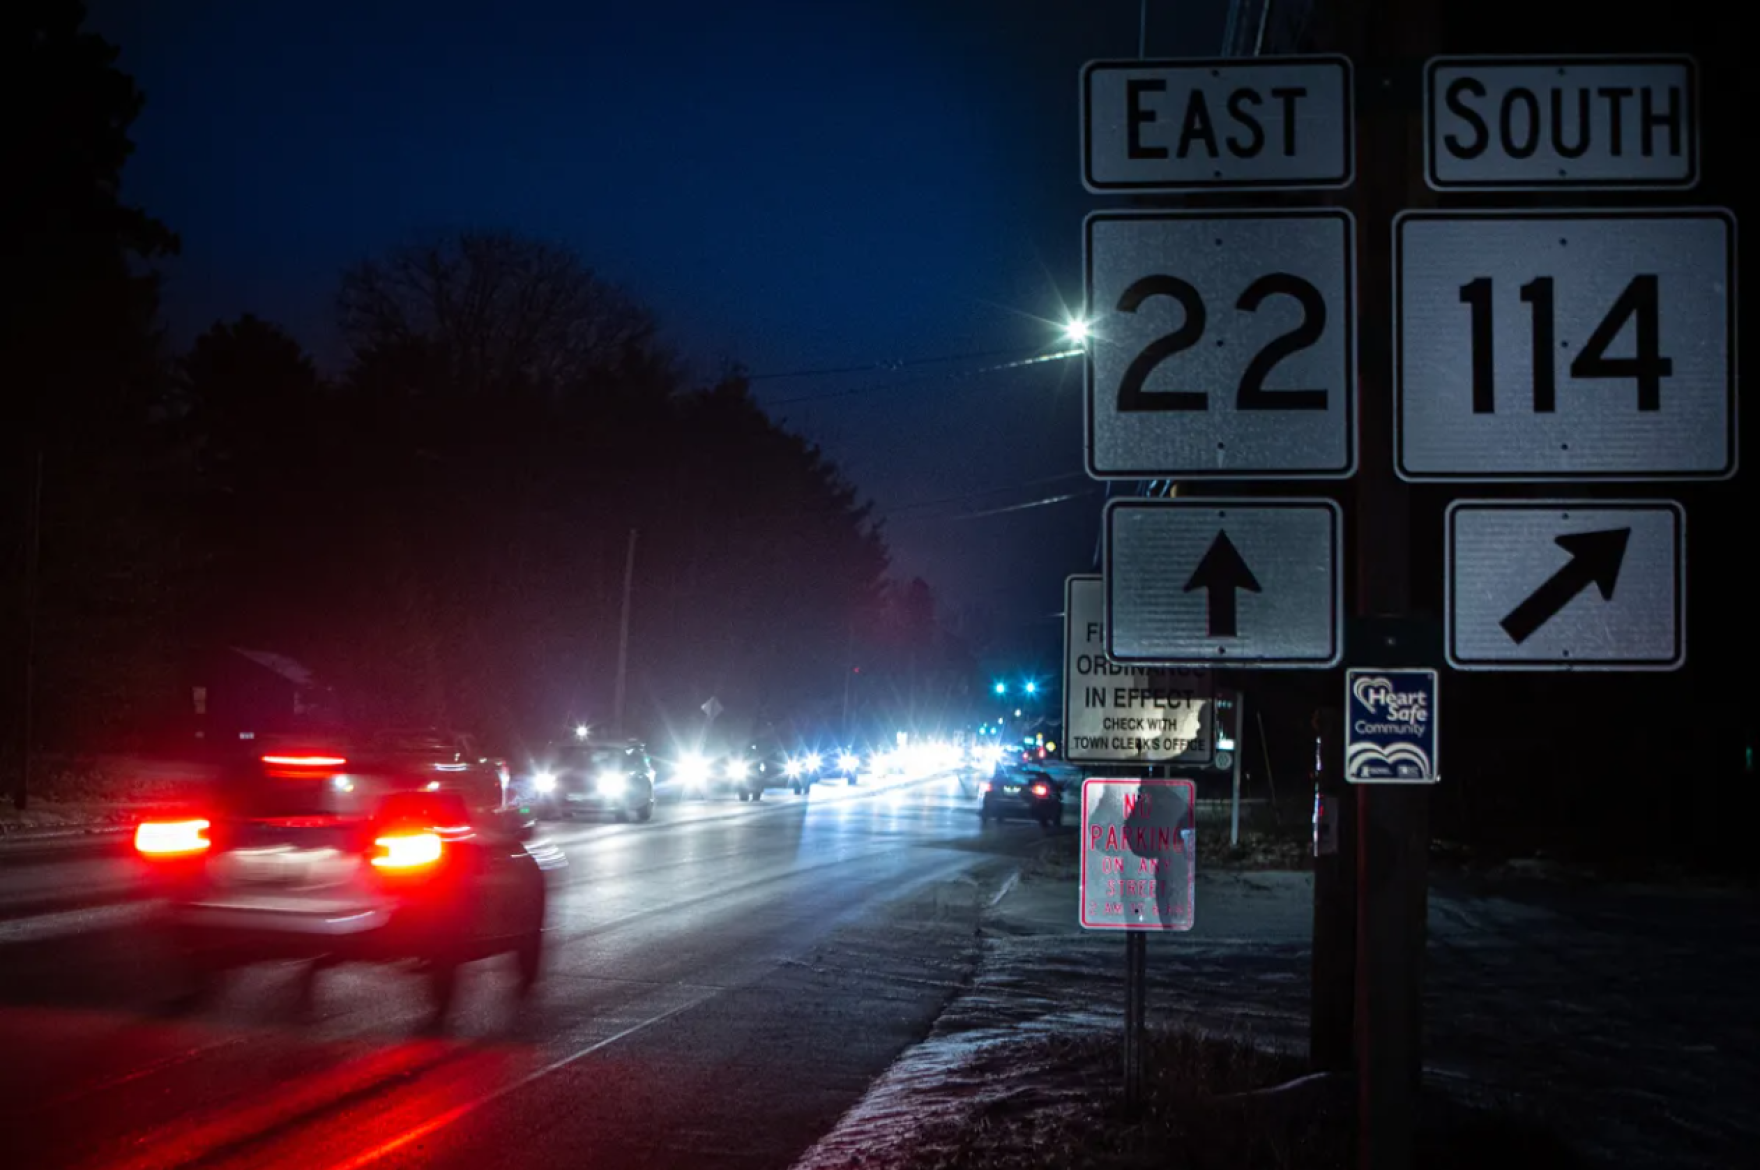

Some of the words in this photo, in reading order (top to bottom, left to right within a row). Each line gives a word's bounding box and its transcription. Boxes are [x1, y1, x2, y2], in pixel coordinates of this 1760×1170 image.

[1125, 79, 1308, 160] EAST
[1443, 77, 1682, 160] SOUTH
[1115, 272, 1329, 413] 22
[1459, 274, 1672, 414] 114
[1085, 688, 1107, 709] IN
[1113, 688, 1195, 709] EFFECT
[1368, 688, 1427, 706] Heart
[1103, 717, 1144, 731] CHECK
[1147, 718, 1177, 731] WITH
[1387, 703, 1428, 725] Safe
[1354, 720, 1425, 738] Community
[1074, 737, 1108, 749] TOWN
[1123, 793, 1153, 819] NO
[1090, 824, 1185, 853] PARKING
[1102, 856, 1124, 874] ON
